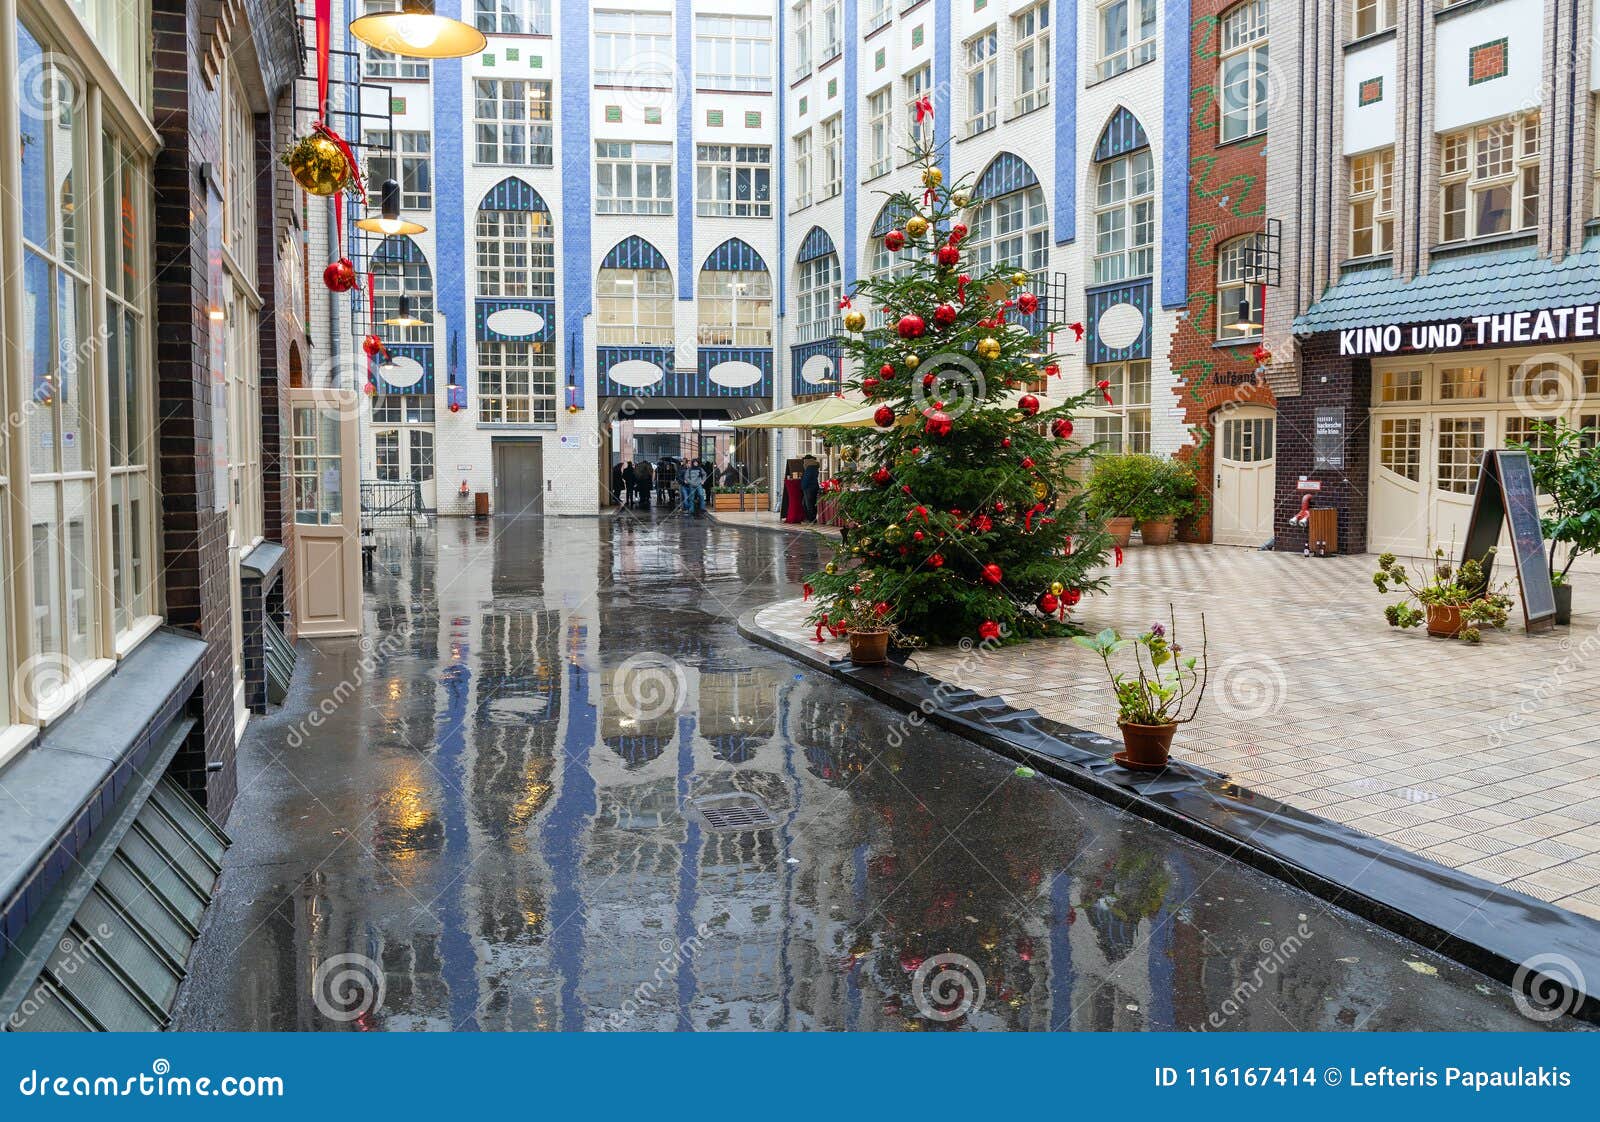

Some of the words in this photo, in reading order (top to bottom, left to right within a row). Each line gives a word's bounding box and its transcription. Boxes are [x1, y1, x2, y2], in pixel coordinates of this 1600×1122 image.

[1340, 325, 1401, 356] KINO
[1411, 323, 1462, 349] UND
[1472, 304, 1600, 345] THEATE
[1213, 371, 1257, 386] Aufgang
